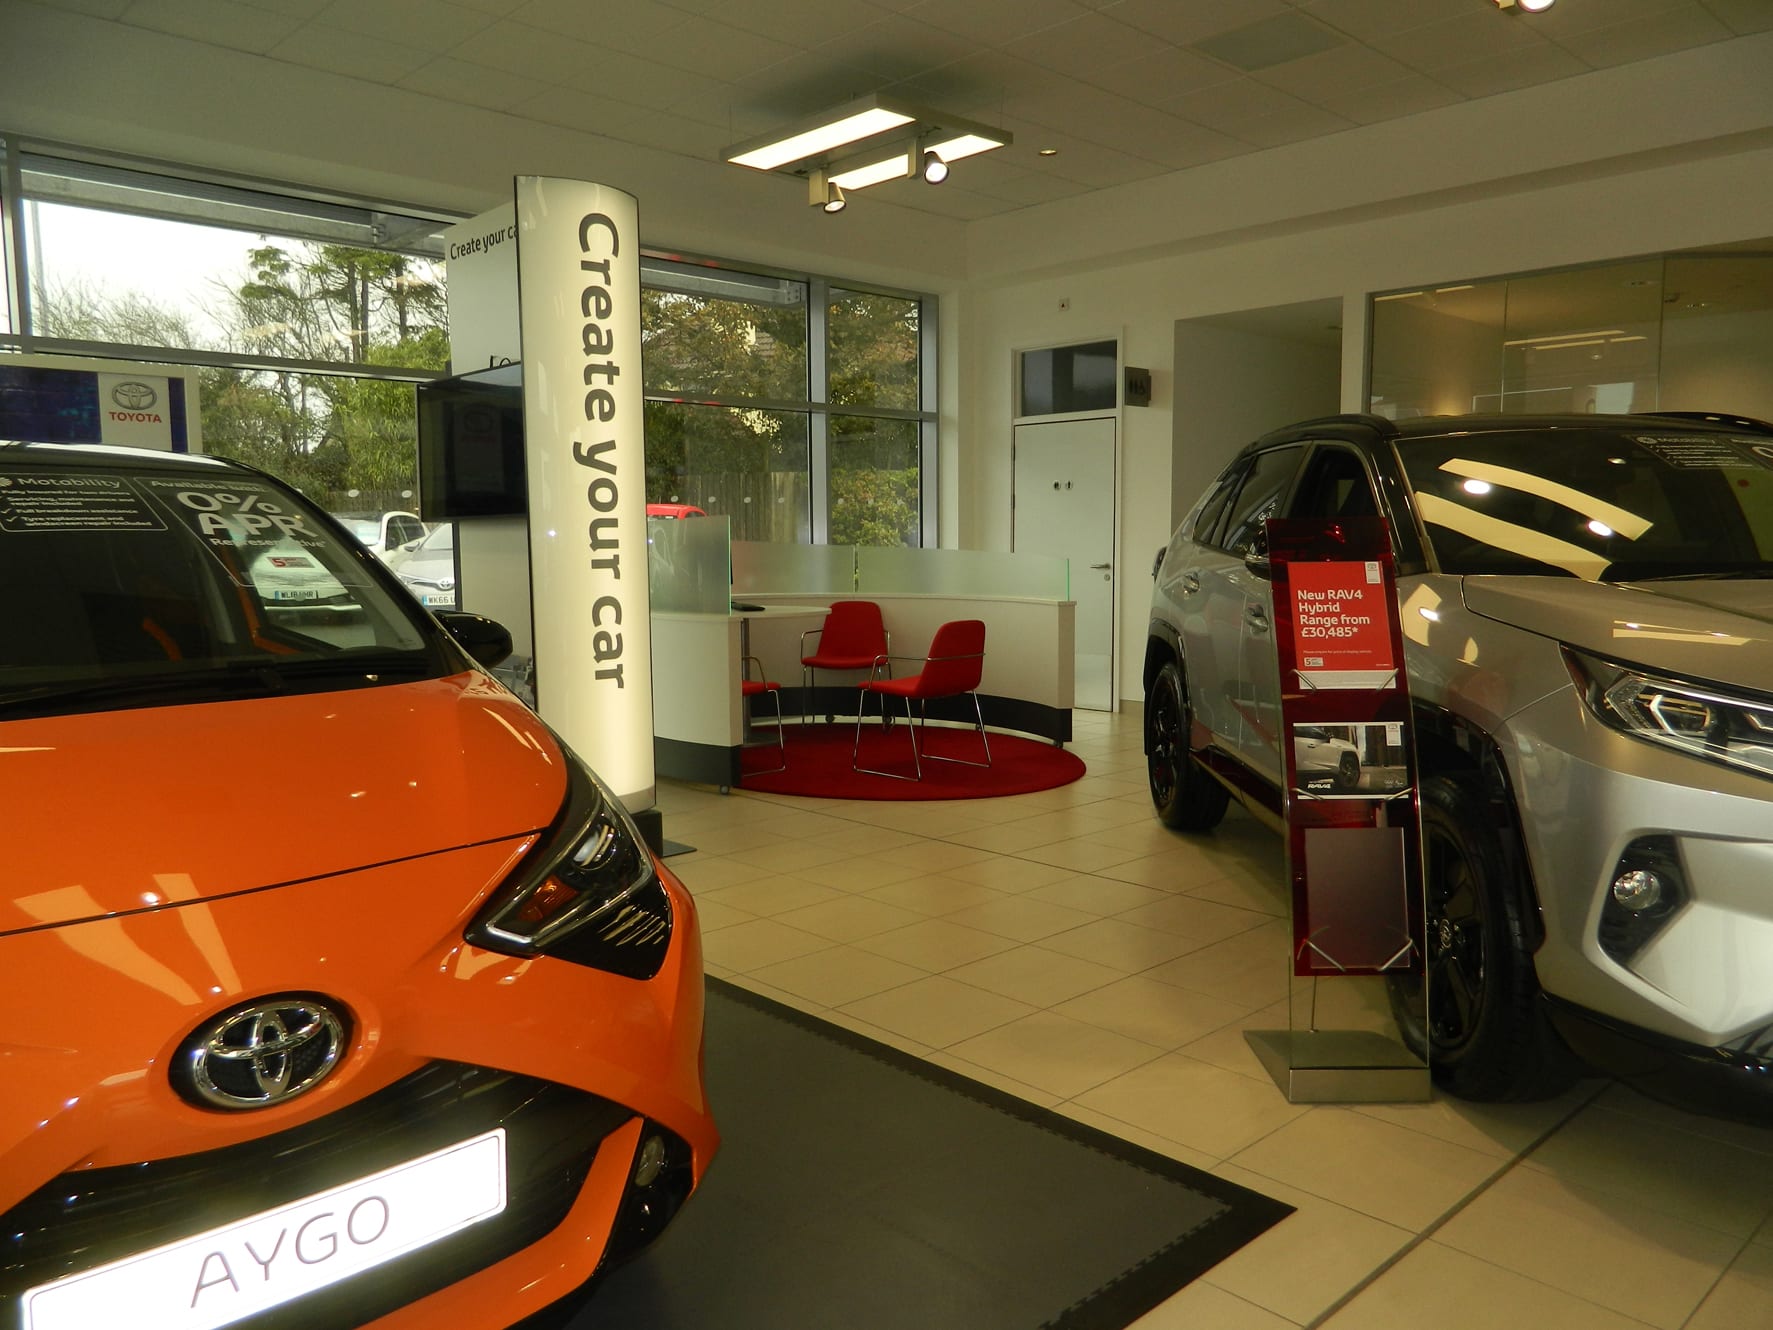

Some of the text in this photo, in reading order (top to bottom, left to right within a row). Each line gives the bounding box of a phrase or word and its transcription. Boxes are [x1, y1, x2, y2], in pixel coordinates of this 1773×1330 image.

[450, 224, 519, 260] Create your ca
[108, 411, 162, 423] TOYOTA
[572, 212, 624, 689] Create your car
[17, 478, 121, 489] Motability
[176, 491, 282, 514] 0%
[198, 512, 319, 538] APR
[1297, 589, 1363, 600] New RAV4
[1298, 602, 1340, 614] Hybrid
[1300, 614, 1370, 627] Range from
[190, 1195, 390, 1309] AYGO
